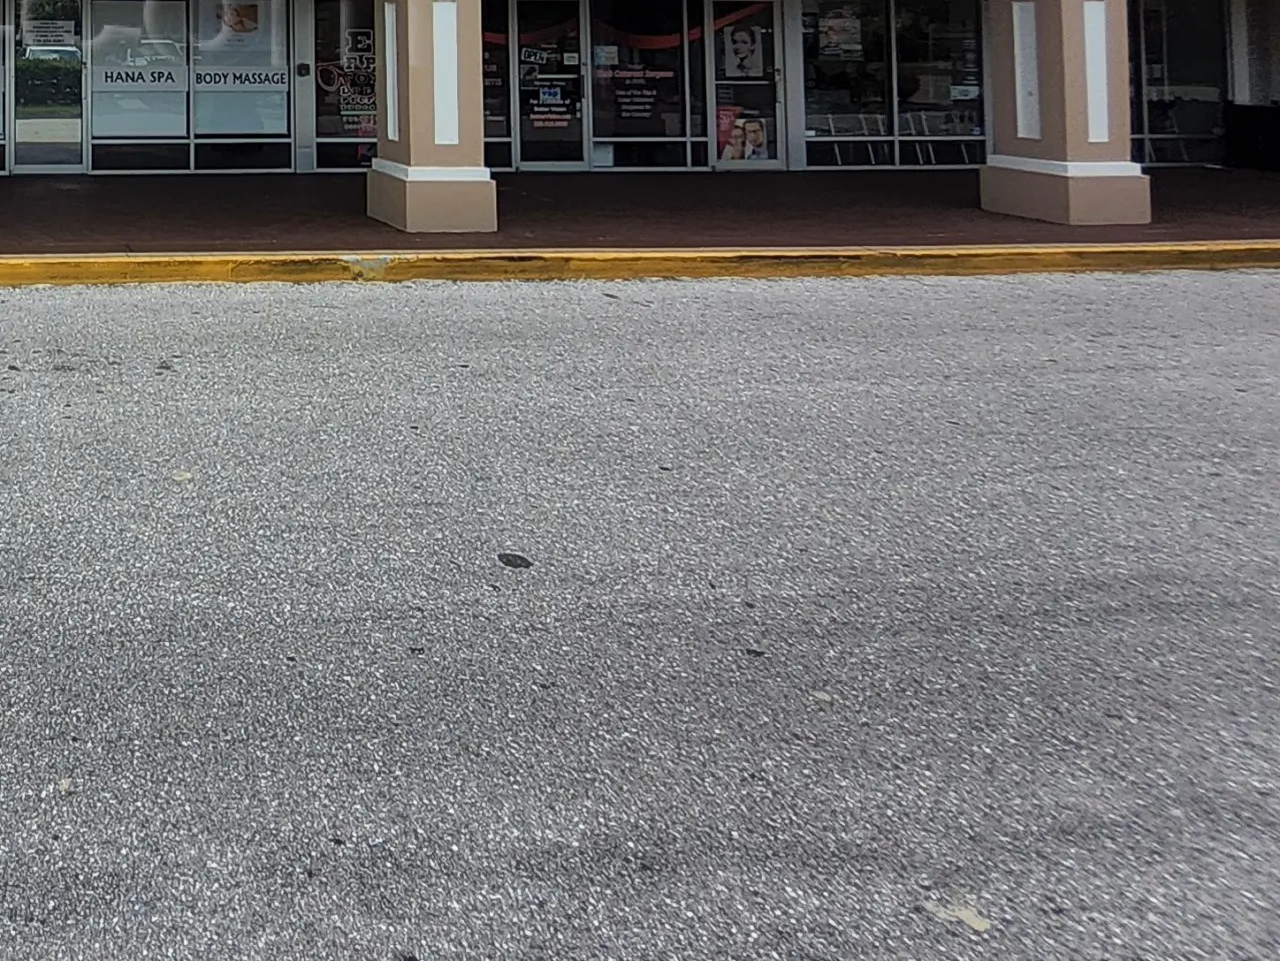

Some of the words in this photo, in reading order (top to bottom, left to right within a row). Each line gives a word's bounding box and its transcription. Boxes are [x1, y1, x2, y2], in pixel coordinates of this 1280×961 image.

[523, 49, 546, 63] OPEN
[104, 71, 148, 83] HANA
[149, 71, 176, 83] SPA
[195, 72, 230, 85] BODY
[232, 72, 287, 85] MASSAGE
